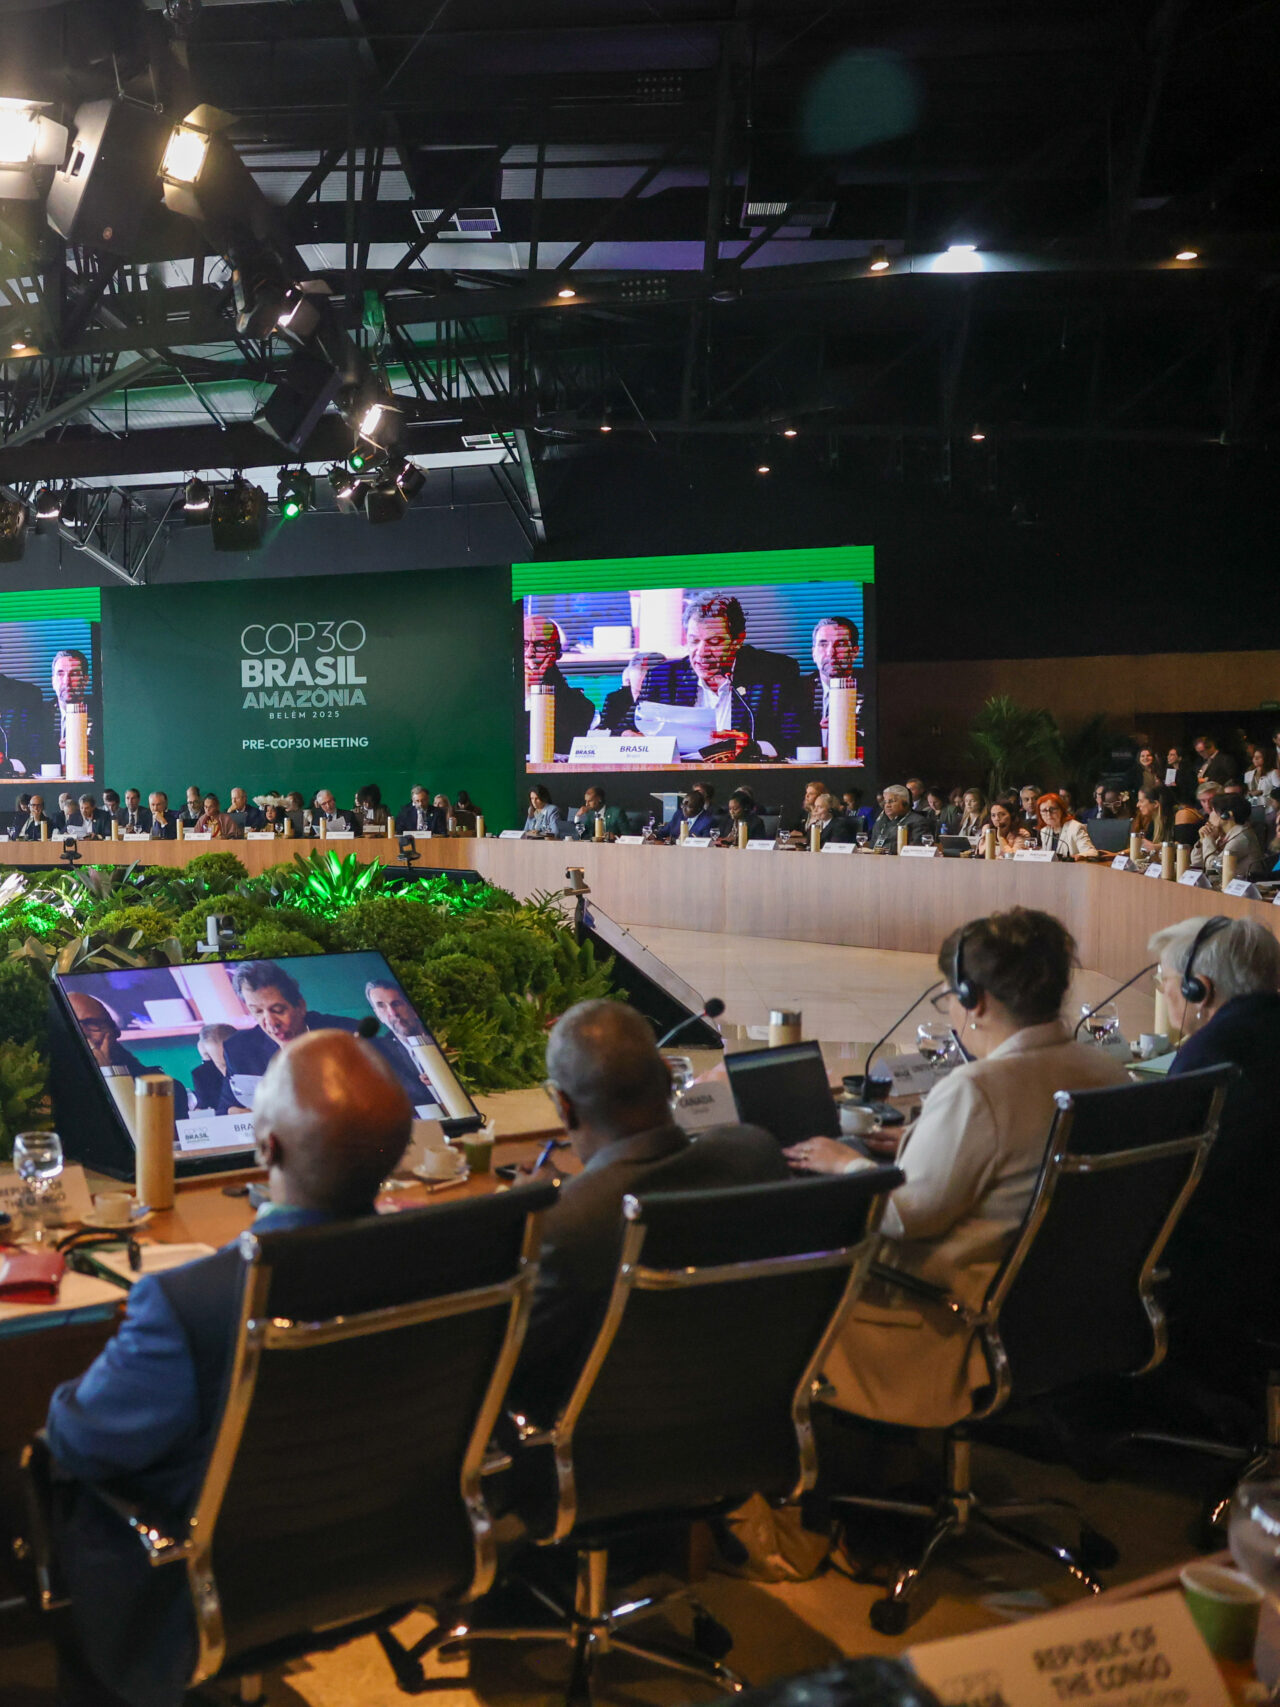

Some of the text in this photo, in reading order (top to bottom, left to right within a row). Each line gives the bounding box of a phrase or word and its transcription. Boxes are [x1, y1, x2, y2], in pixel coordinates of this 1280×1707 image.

[241, 620, 366, 656] COP30
[241, 655, 367, 688] BRASIL
[242, 687, 367, 709] AMAZÔNIA
[312, 710, 340, 719] 2025
[242, 737, 369, 750] PRE-COP30 MEETING
[619, 745, 649, 753] BRASIL
[1033, 1625, 1157, 1672] REPUBLIC OF
[1051, 1671, 1093, 1701] THE
[1094, 1652, 1172, 1690] CONGO
